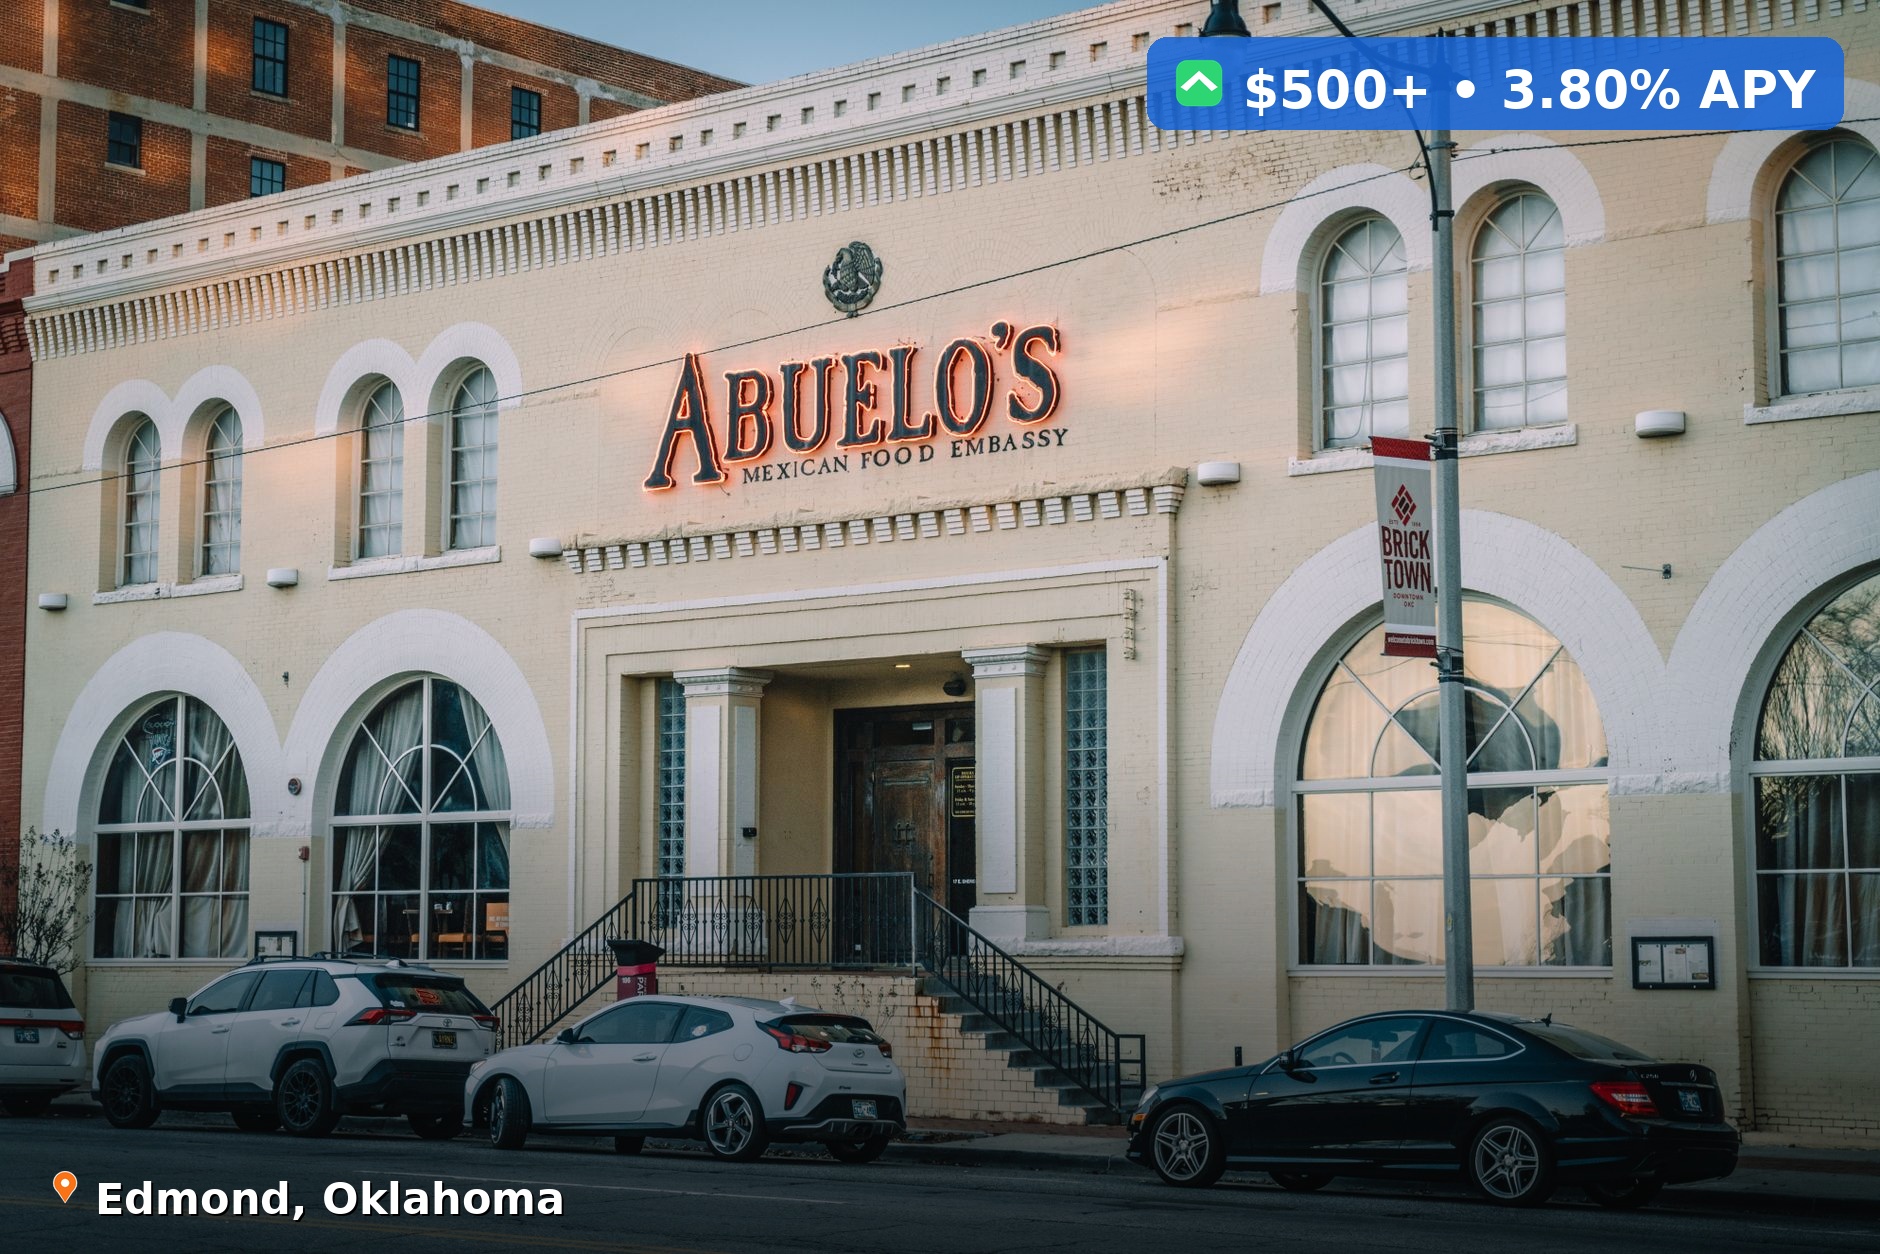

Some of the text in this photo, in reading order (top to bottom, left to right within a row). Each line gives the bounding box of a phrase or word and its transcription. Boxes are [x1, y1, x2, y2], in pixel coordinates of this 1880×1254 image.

[643, 320, 1061, 490] ABUELO'S
[743, 428, 1068, 484] MEXICAN FOOD EMBASSY
[1381, 526, 1431, 559] BRICK
[1383, 558, 1432, 594] TOWN
[1393, 592, 1424, 601] DOWNTOWN
[1403, 600, 1415, 608] OKC
